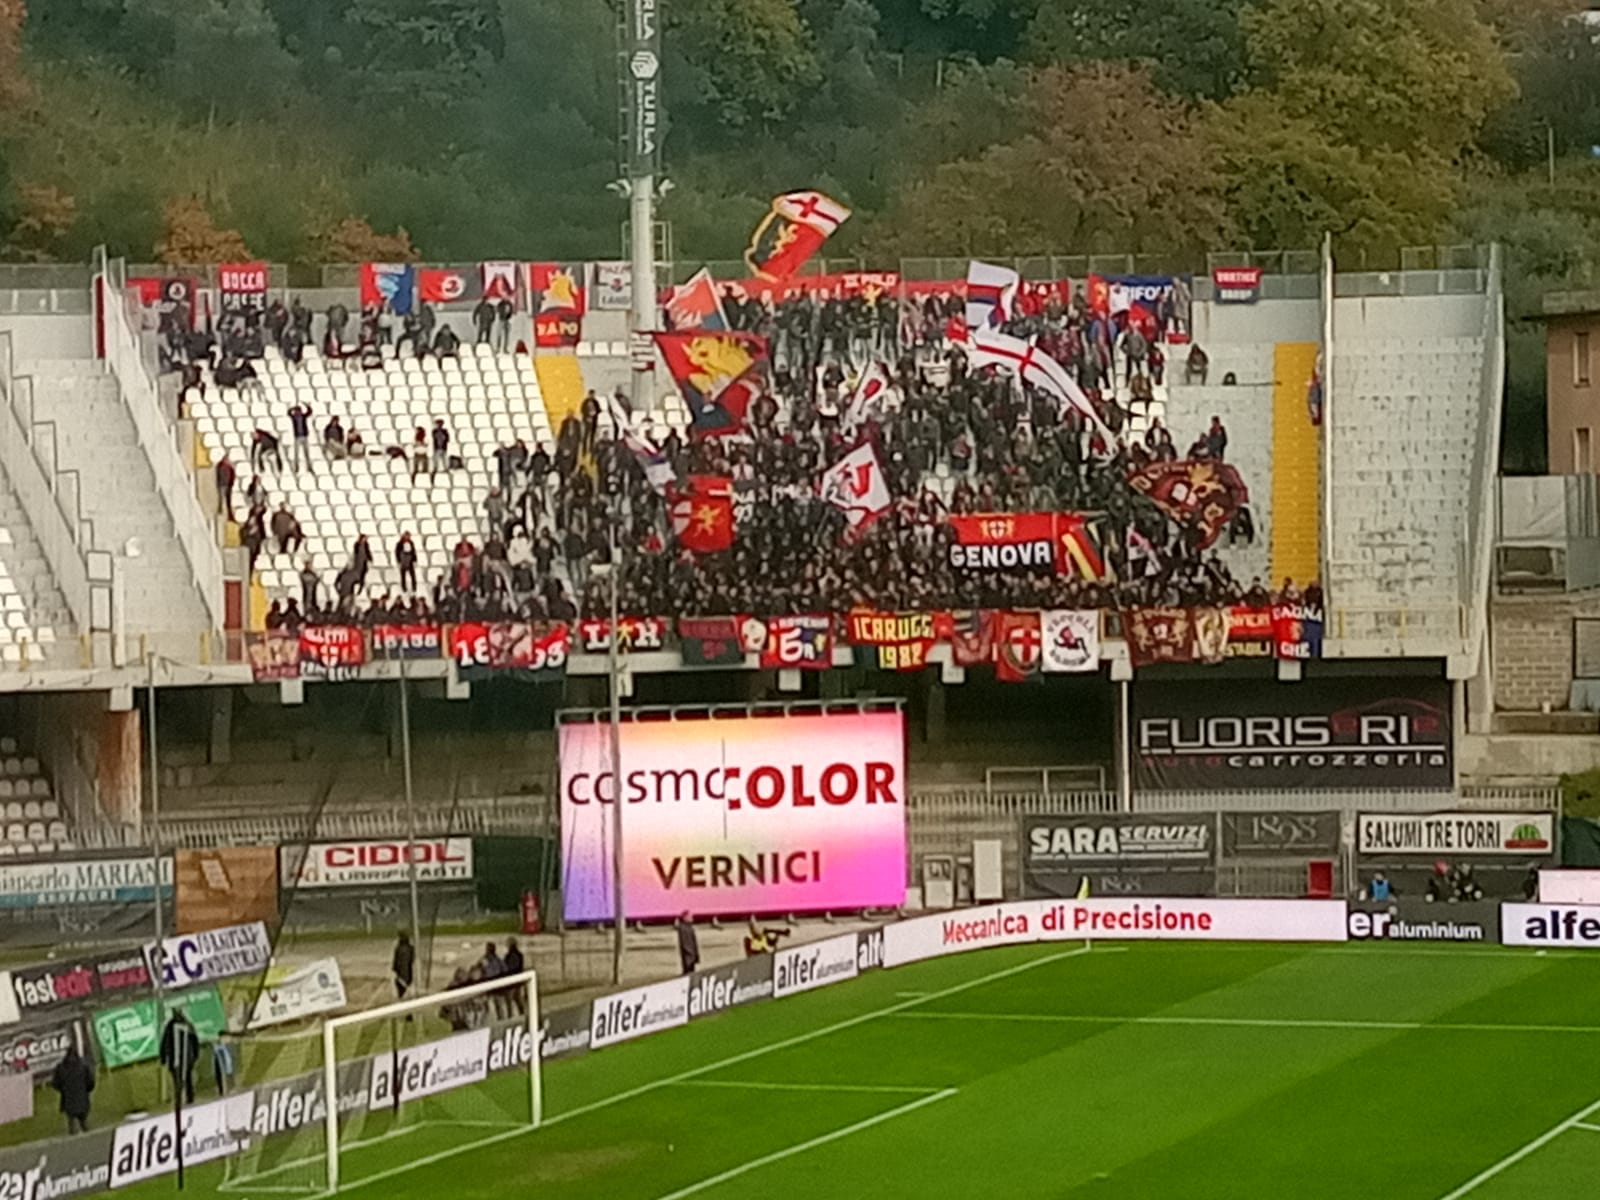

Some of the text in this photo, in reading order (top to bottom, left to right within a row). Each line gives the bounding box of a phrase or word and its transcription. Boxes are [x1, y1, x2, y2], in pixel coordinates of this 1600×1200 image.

[950, 542, 1050, 568] GENOVA
[1030, 824, 1208, 854] SARA SERVIZI
[1364, 819, 1501, 848] SALUMI TRE TORRI
[325, 842, 465, 868] CIDOL
[652, 851, 822, 890] VERNICI
[943, 904, 1213, 944] Meccanica di Precisione
[1389, 920, 1482, 940] aluminium
[1525, 909, 1600, 940] alfe
[776, 953, 817, 990] alfer
[690, 974, 737, 1017] alfer
[595, 998, 643, 1040] alfer
[374, 1054, 434, 1102] afer
[253, 1086, 318, 1137] alfer
